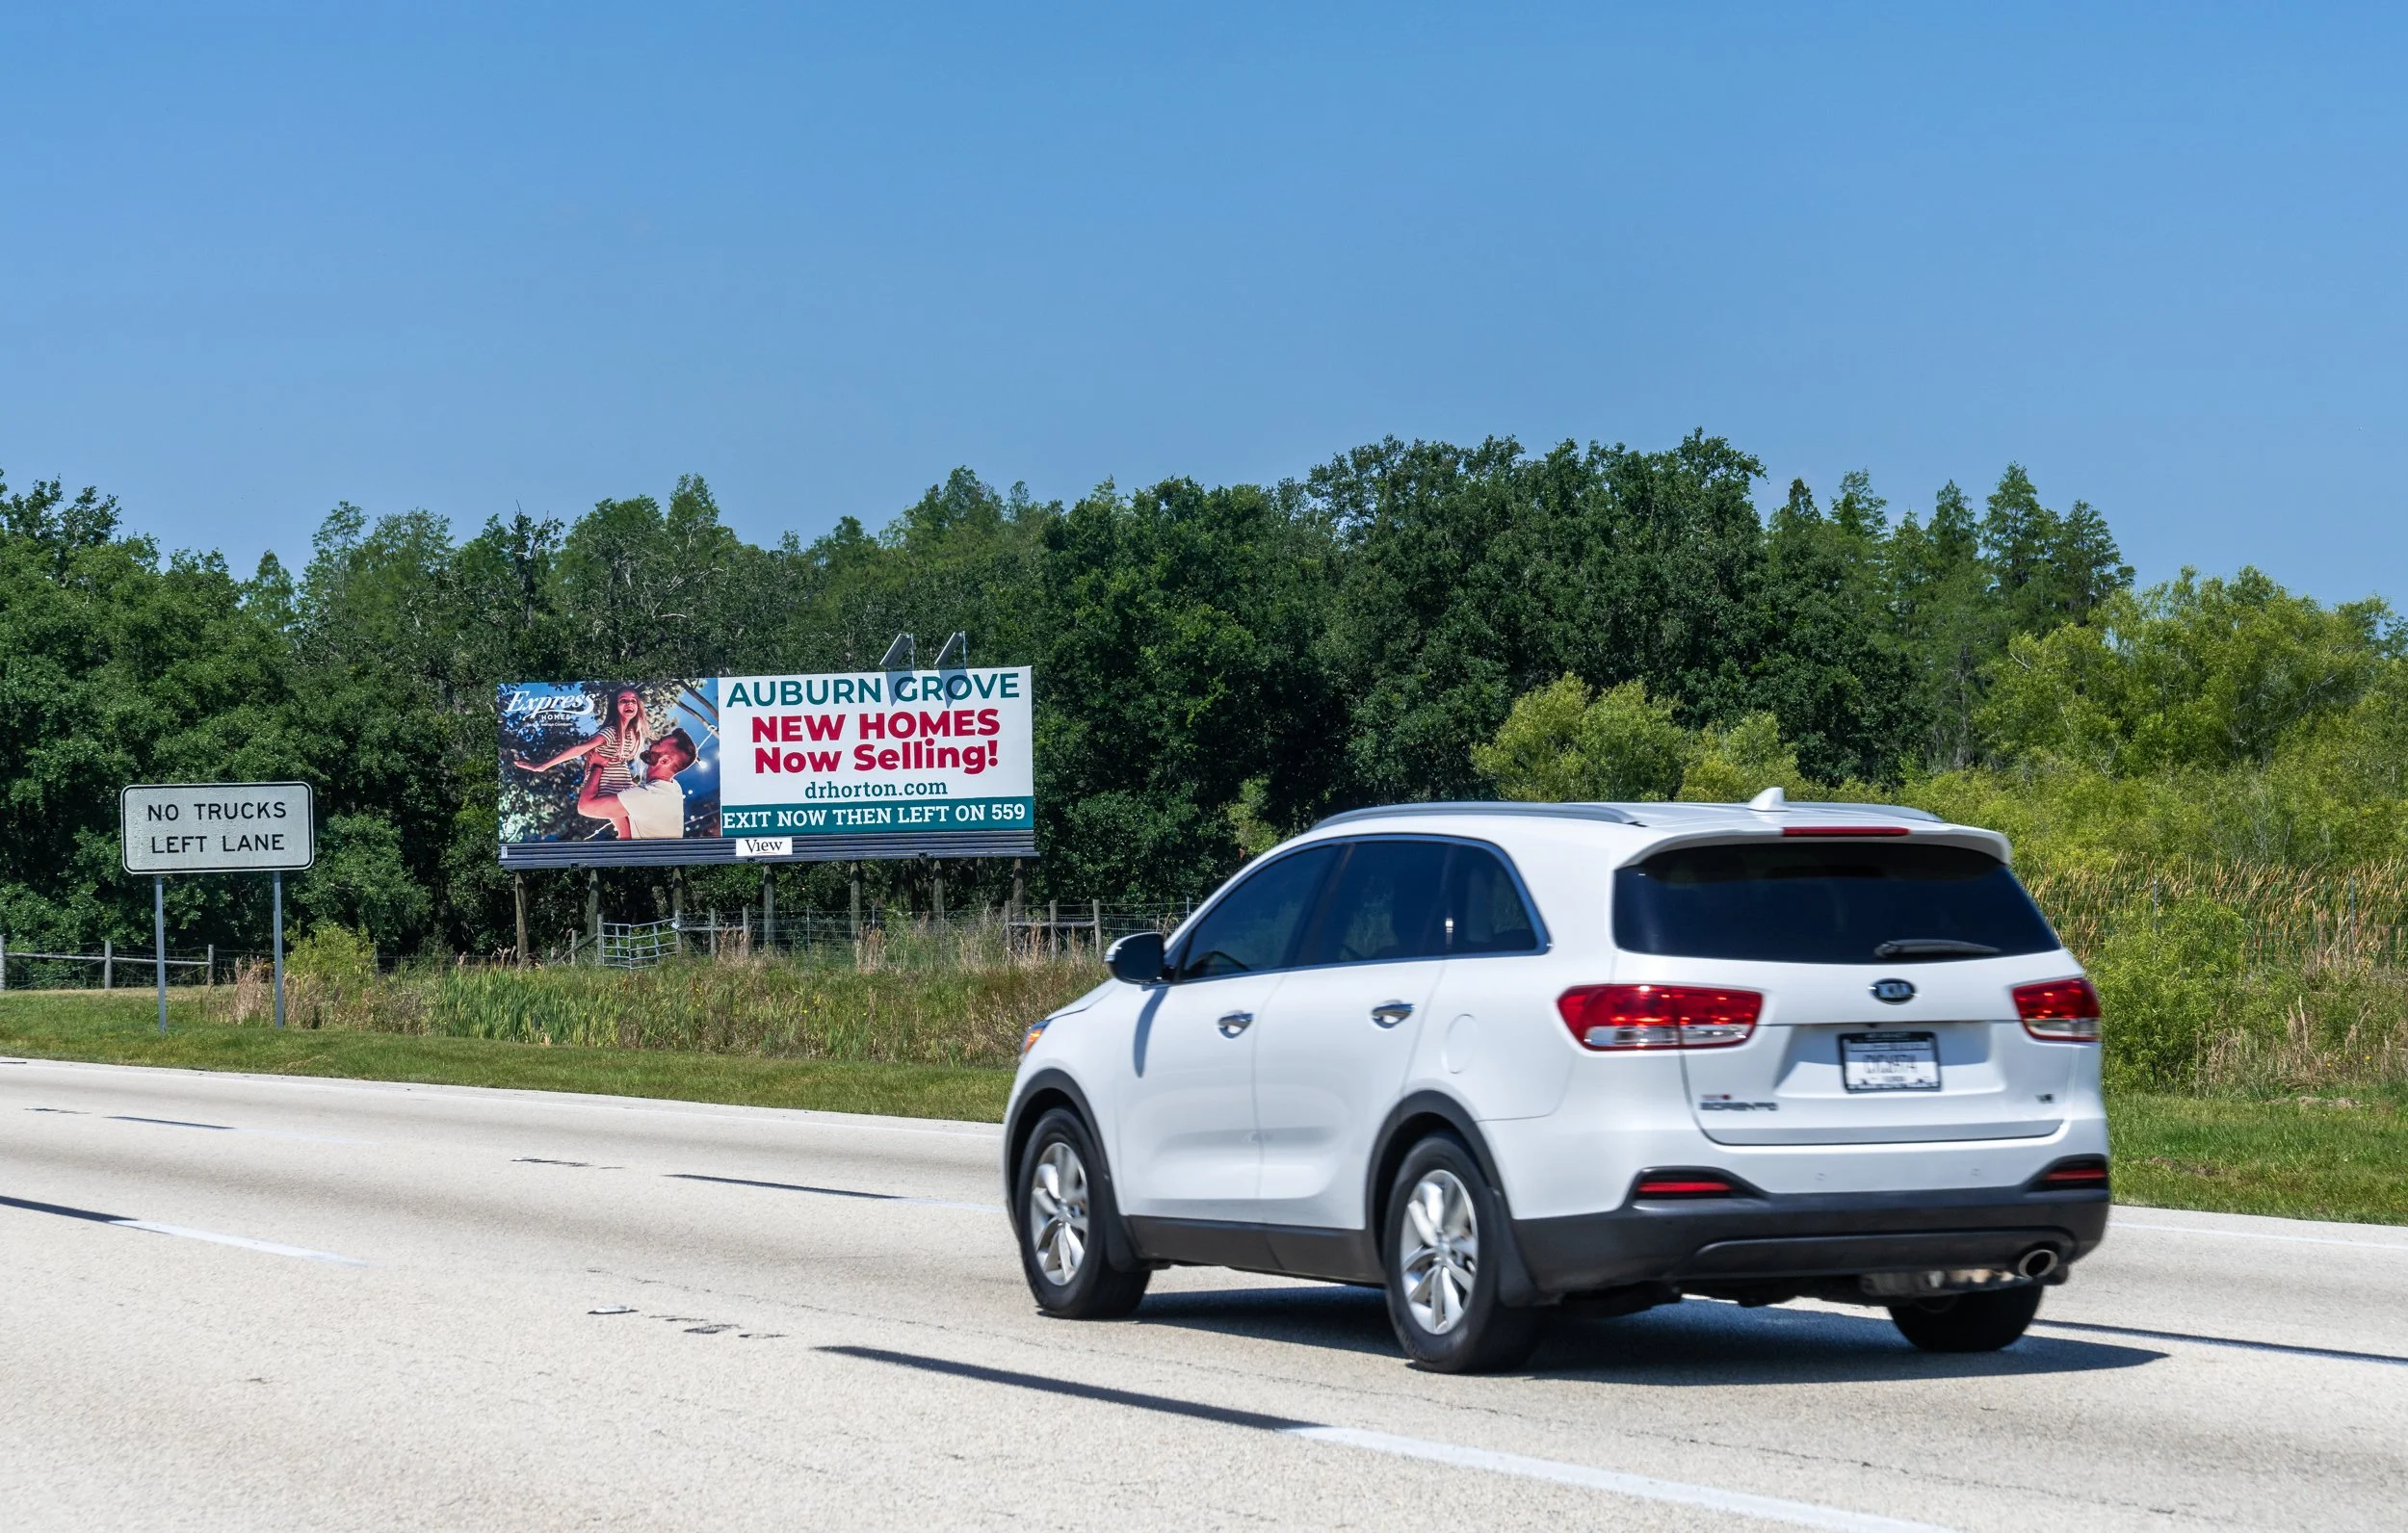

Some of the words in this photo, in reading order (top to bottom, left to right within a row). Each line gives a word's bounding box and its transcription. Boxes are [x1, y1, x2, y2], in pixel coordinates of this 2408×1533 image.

[726, 677, 881, 708] AUBURN
[894, 672, 1020, 702] GROVE
[505, 690, 596, 721] Express
[751, 714, 847, 743] NEW
[859, 708, 1000, 741] HOMES
[754, 746, 843, 774] Now
[853, 739, 999, 775] Selling!
[804, 780, 948, 799] drhorton.com
[147, 803, 179, 821] NO
[194, 801, 287, 819] TRUCKS
[722, 811, 772, 829] EXIT
[776, 809, 827, 827] NOW
[832, 807, 892, 825] THEN
[897, 805, 950, 824] LEFT
[955, 804, 985, 822] ON
[991, 803, 1026, 820] 559
[151, 835, 208, 854] LEFT
[222, 834, 285, 852] LANE
[745, 839, 783, 852] View
